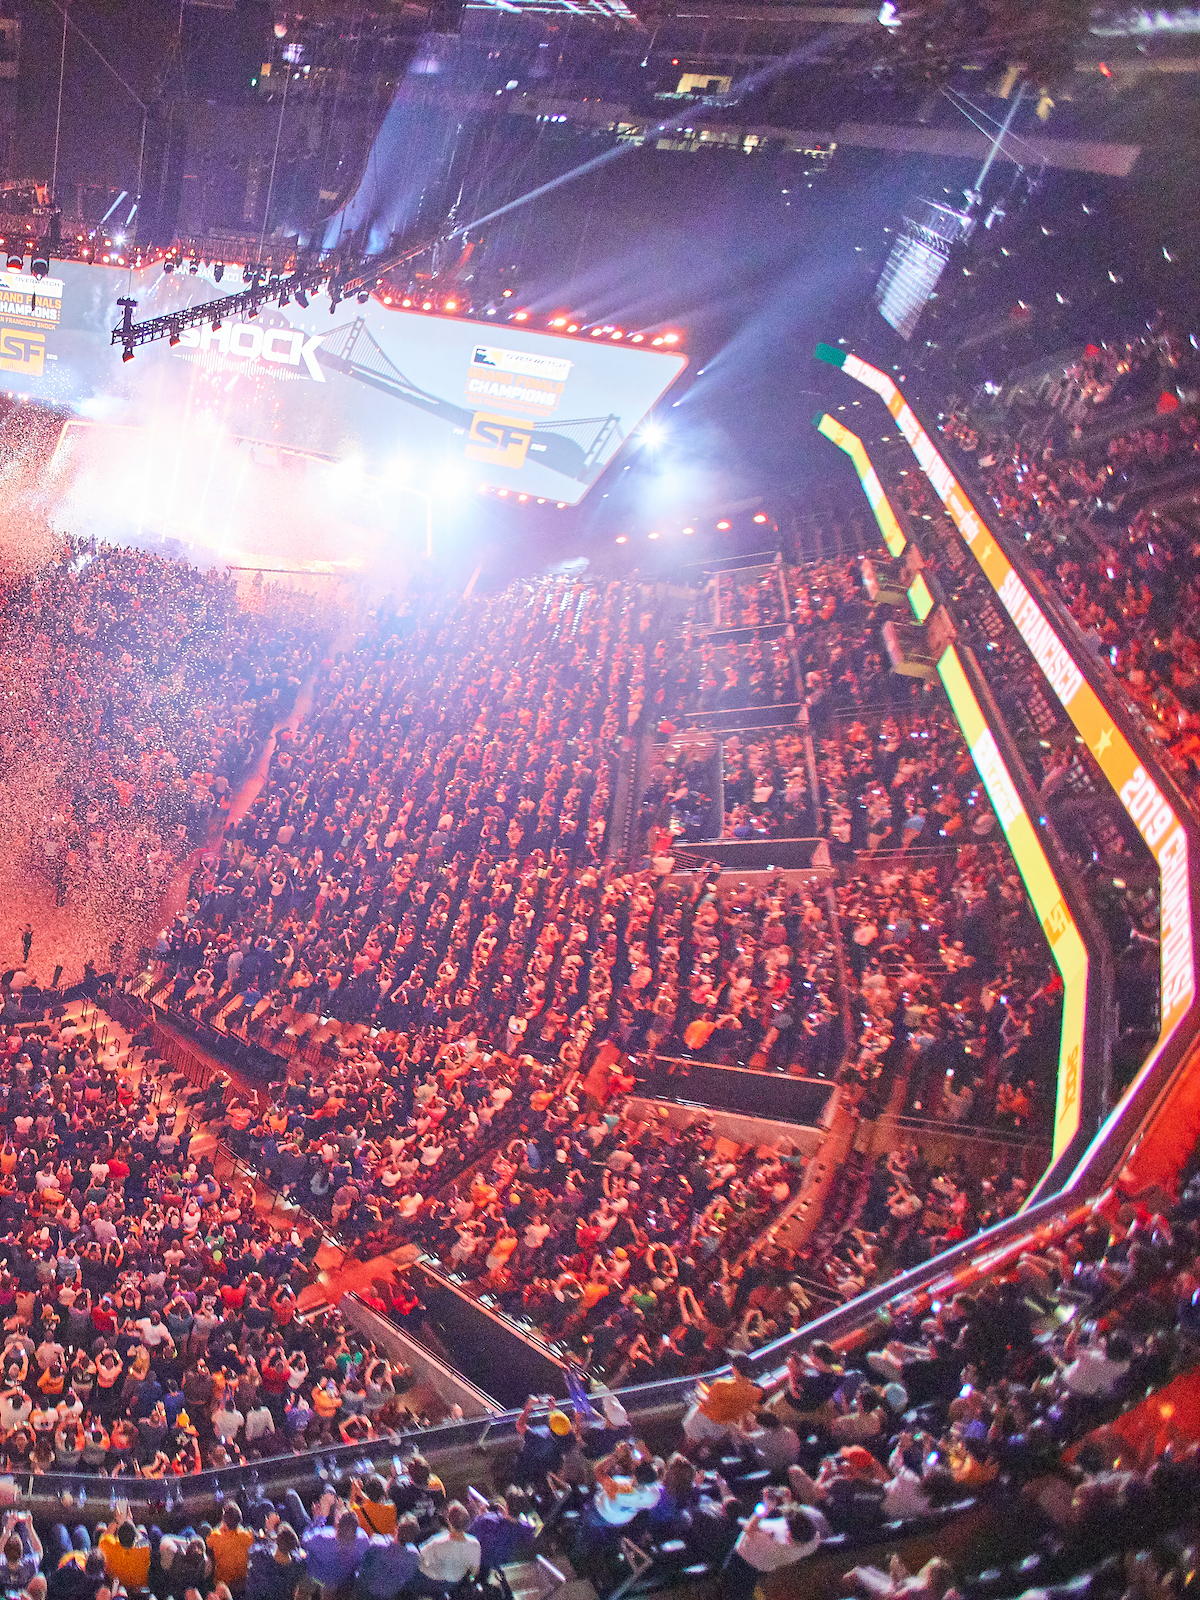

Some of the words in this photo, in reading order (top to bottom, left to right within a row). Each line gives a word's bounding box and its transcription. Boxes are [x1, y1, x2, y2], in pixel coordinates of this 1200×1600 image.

[26, 294, 62, 310] FNALS
[467, 367, 513, 384] GRAND
[516, 375, 565, 394] FINALS
[468, 379, 557, 406] CHAMPIONS
[998, 569, 1032, 620] SAN
[1016, 601, 1083, 706] FRANCISCO
[1120, 765, 1173, 848] 2019
[1158, 825, 1194, 1019] CHAMPIONS!
[1060, 1044, 1079, 1123] SHOCK
